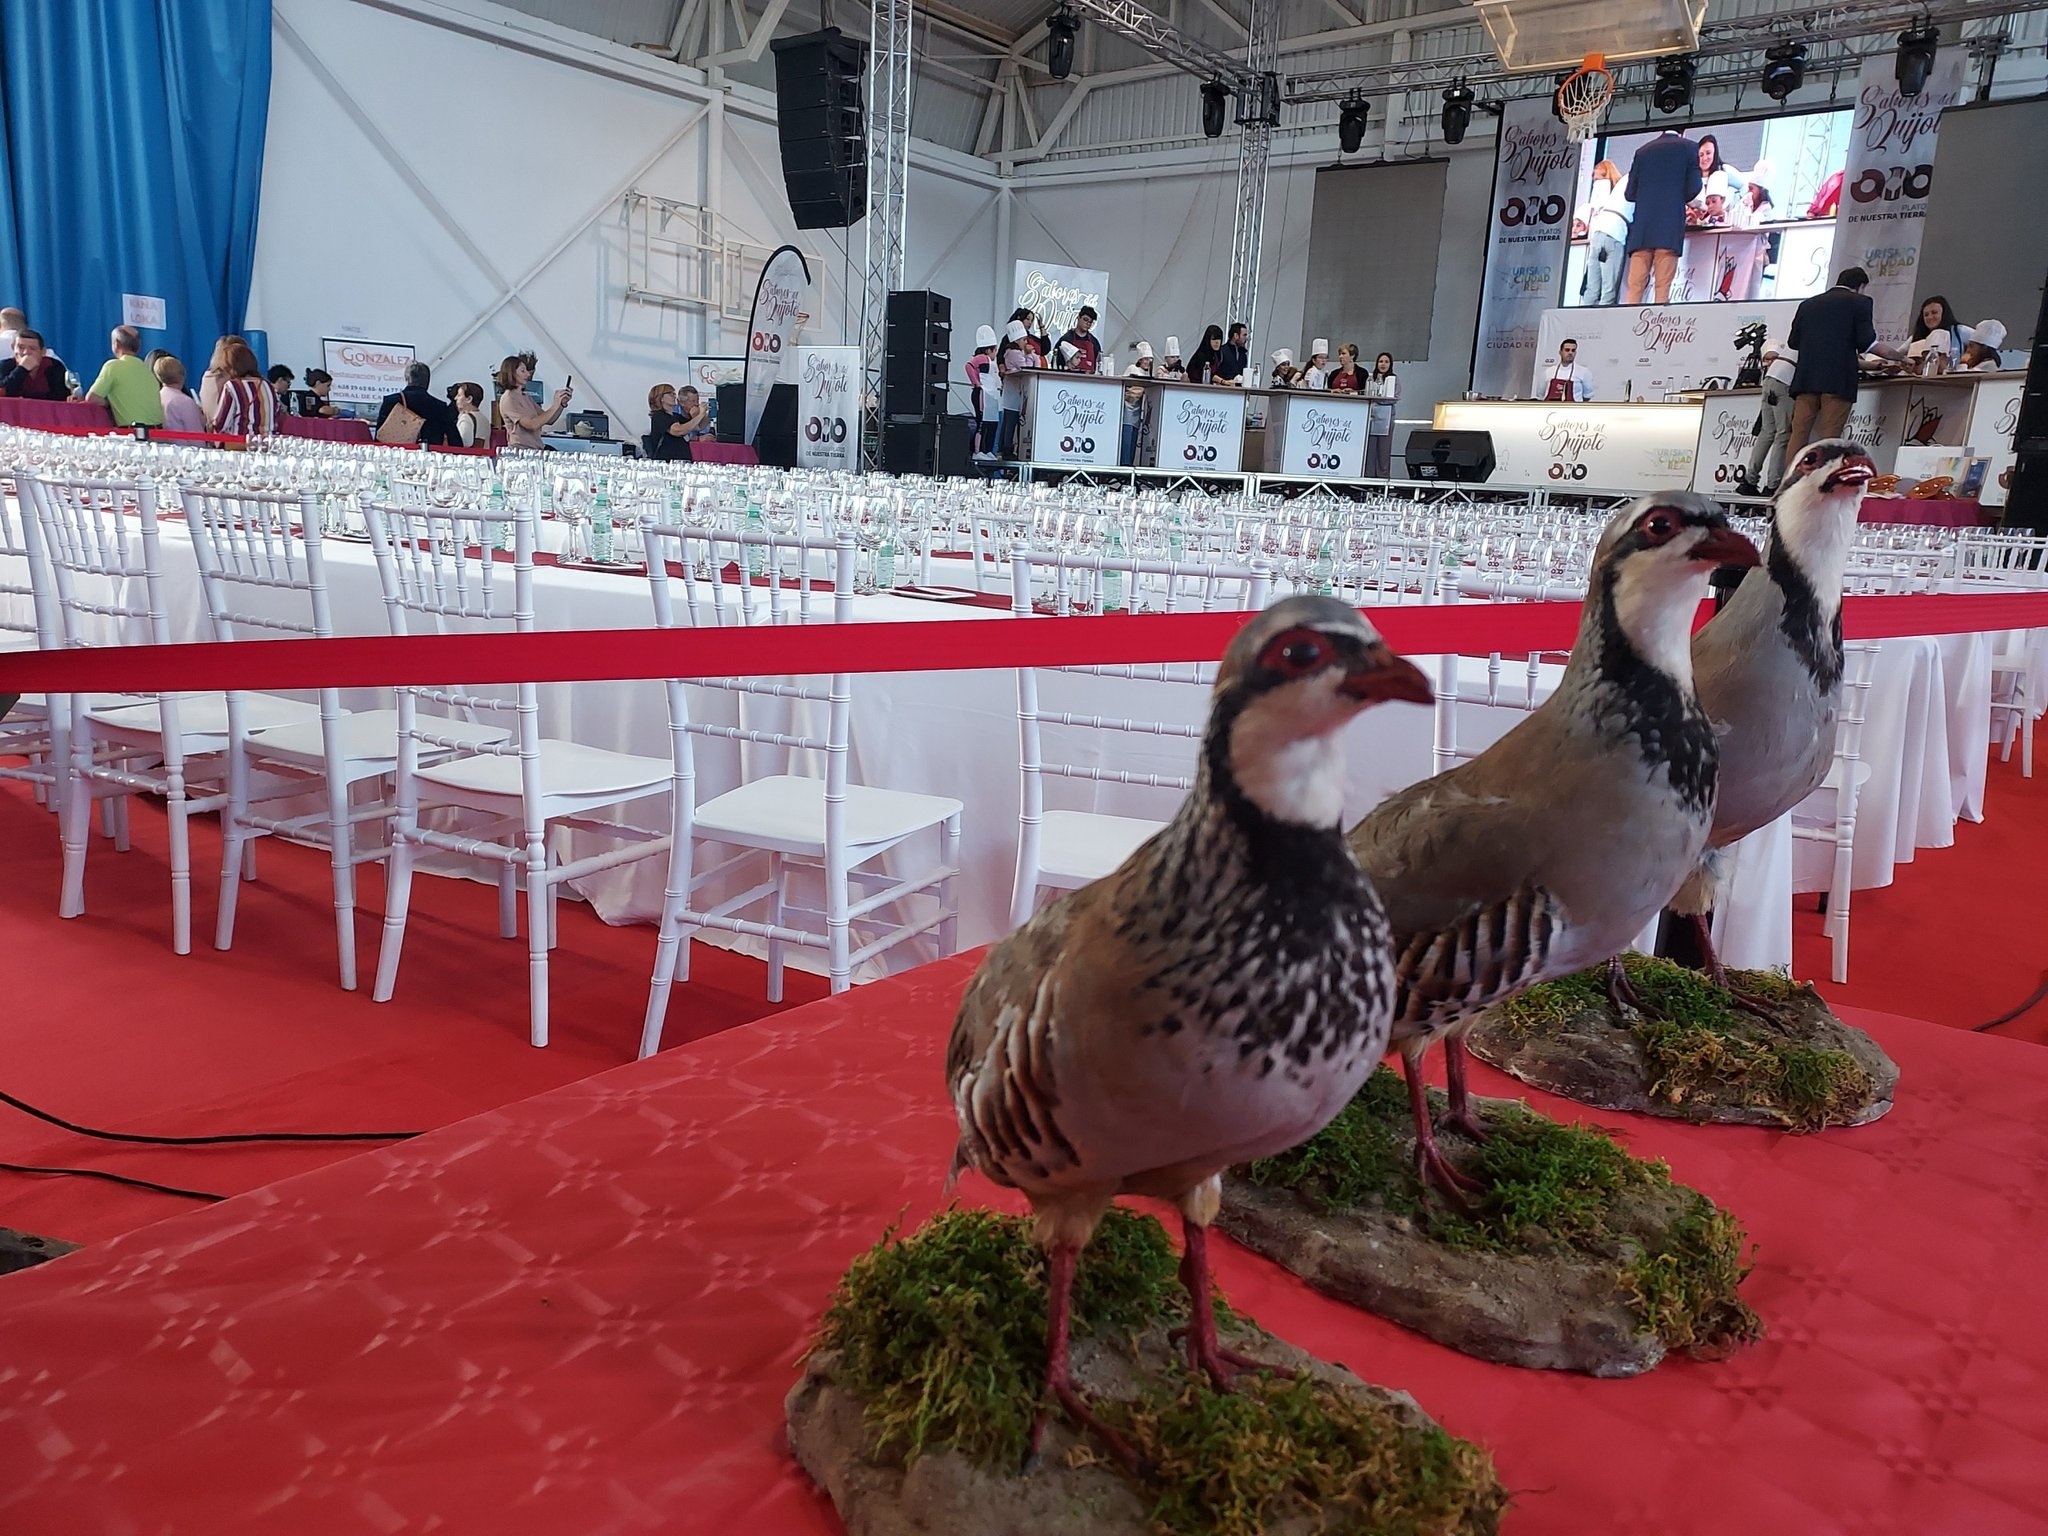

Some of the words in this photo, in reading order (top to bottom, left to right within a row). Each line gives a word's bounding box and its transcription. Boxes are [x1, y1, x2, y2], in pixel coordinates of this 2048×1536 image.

[1855, 85, 1930, 130] Sabores
[1501, 125, 1557, 164] Sabores
[1866, 108, 1943, 155] Quijot
[1510, 145, 1577, 186] Quijote
[1848, 215, 1858, 223] DE
[1859, 211, 1898, 222] NUESTRA
[1508, 235, 1537, 244] NUESTRA
[1537, 234, 1561, 242] TIERRA
[1866, 257, 1915, 268] CIUDAD
[760, 279, 790, 305] Sabores
[1018, 270, 1080, 312] Sabores
[1513, 274, 1550, 284] CIUDAD
[766, 296, 800, 326] Quijote
[1632, 308, 1681, 336] Sabores
[1643, 324, 1698, 354] Quijote
[1878, 334, 1908, 342] REAL
[333, 391, 359, 399] MORAL
[1052, 390, 1092, 414] Sabores
[1063, 406, 1106, 433] Quijote
[1176, 400, 1216, 424] Sabores
[1302, 409, 1339, 432] Sabores
[1712, 411, 1749, 440] Sabores
[1186, 415, 1229, 442] Quijote
[1311, 424, 1352, 450] Quijote
[1539, 412, 1589, 441] Sabores
[1550, 430, 1607, 461] Quijote
